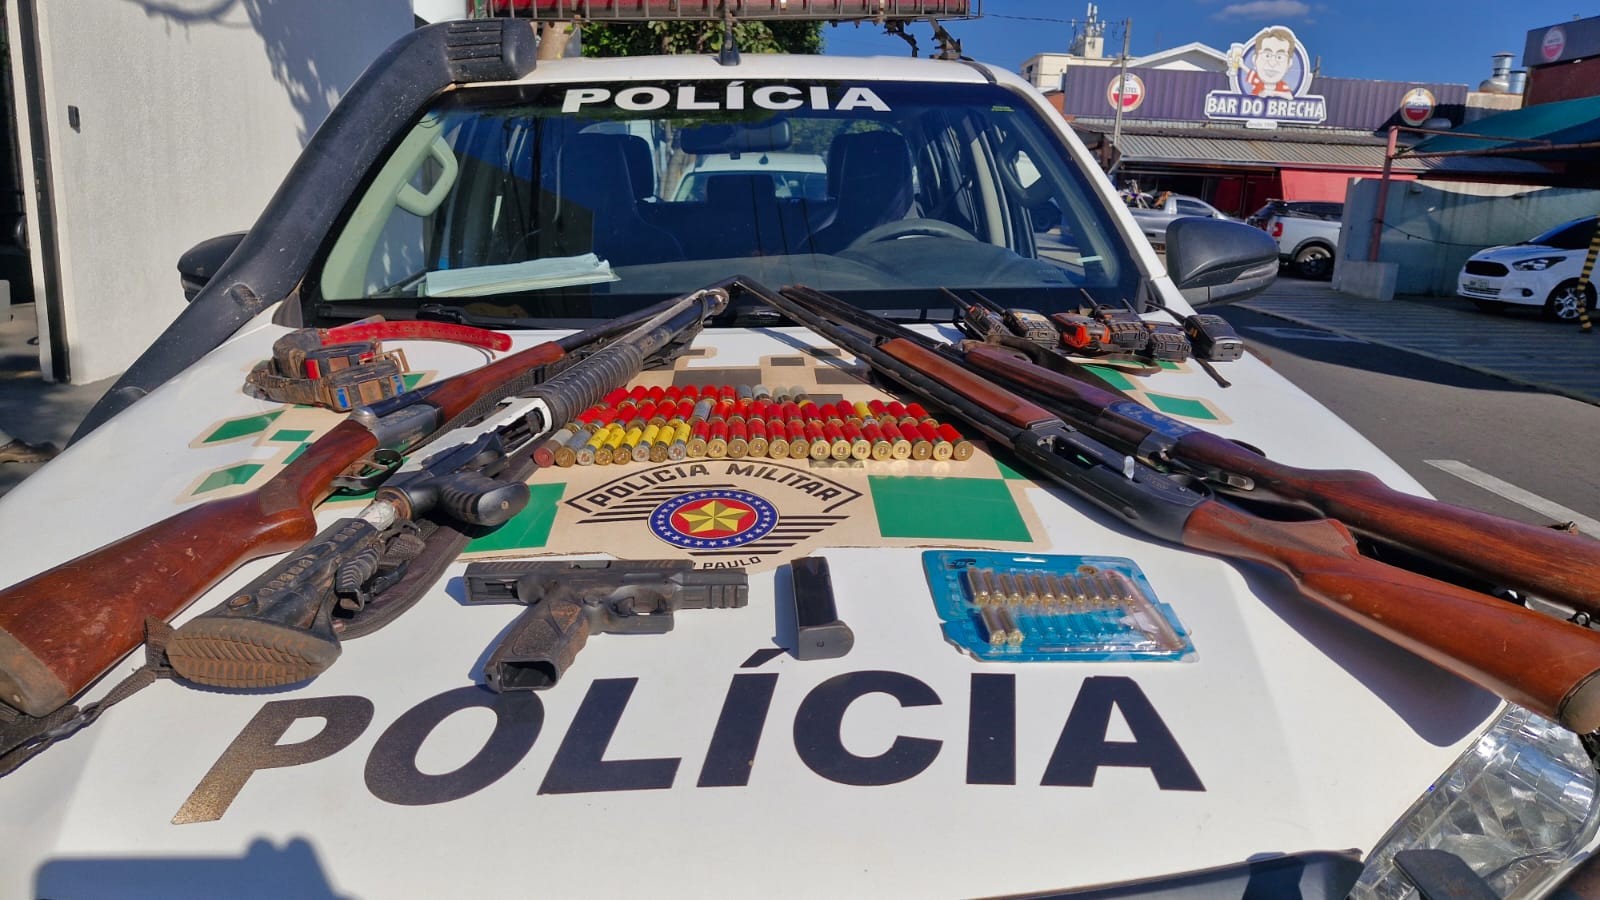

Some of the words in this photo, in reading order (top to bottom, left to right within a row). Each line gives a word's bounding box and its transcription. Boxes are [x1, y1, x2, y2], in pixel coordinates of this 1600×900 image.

[561, 80, 891, 113] POLÍCIA
[1207, 97, 1237, 114] BAR
[1241, 99, 1263, 115] DO
[1267, 100, 1324, 118] BRECHA
[586, 463, 710, 507] POLICIA
[725, 463, 842, 502] MILITAR
[703, 556, 761, 569] PAULO
[170, 646, 1207, 825] POLÍCIA
